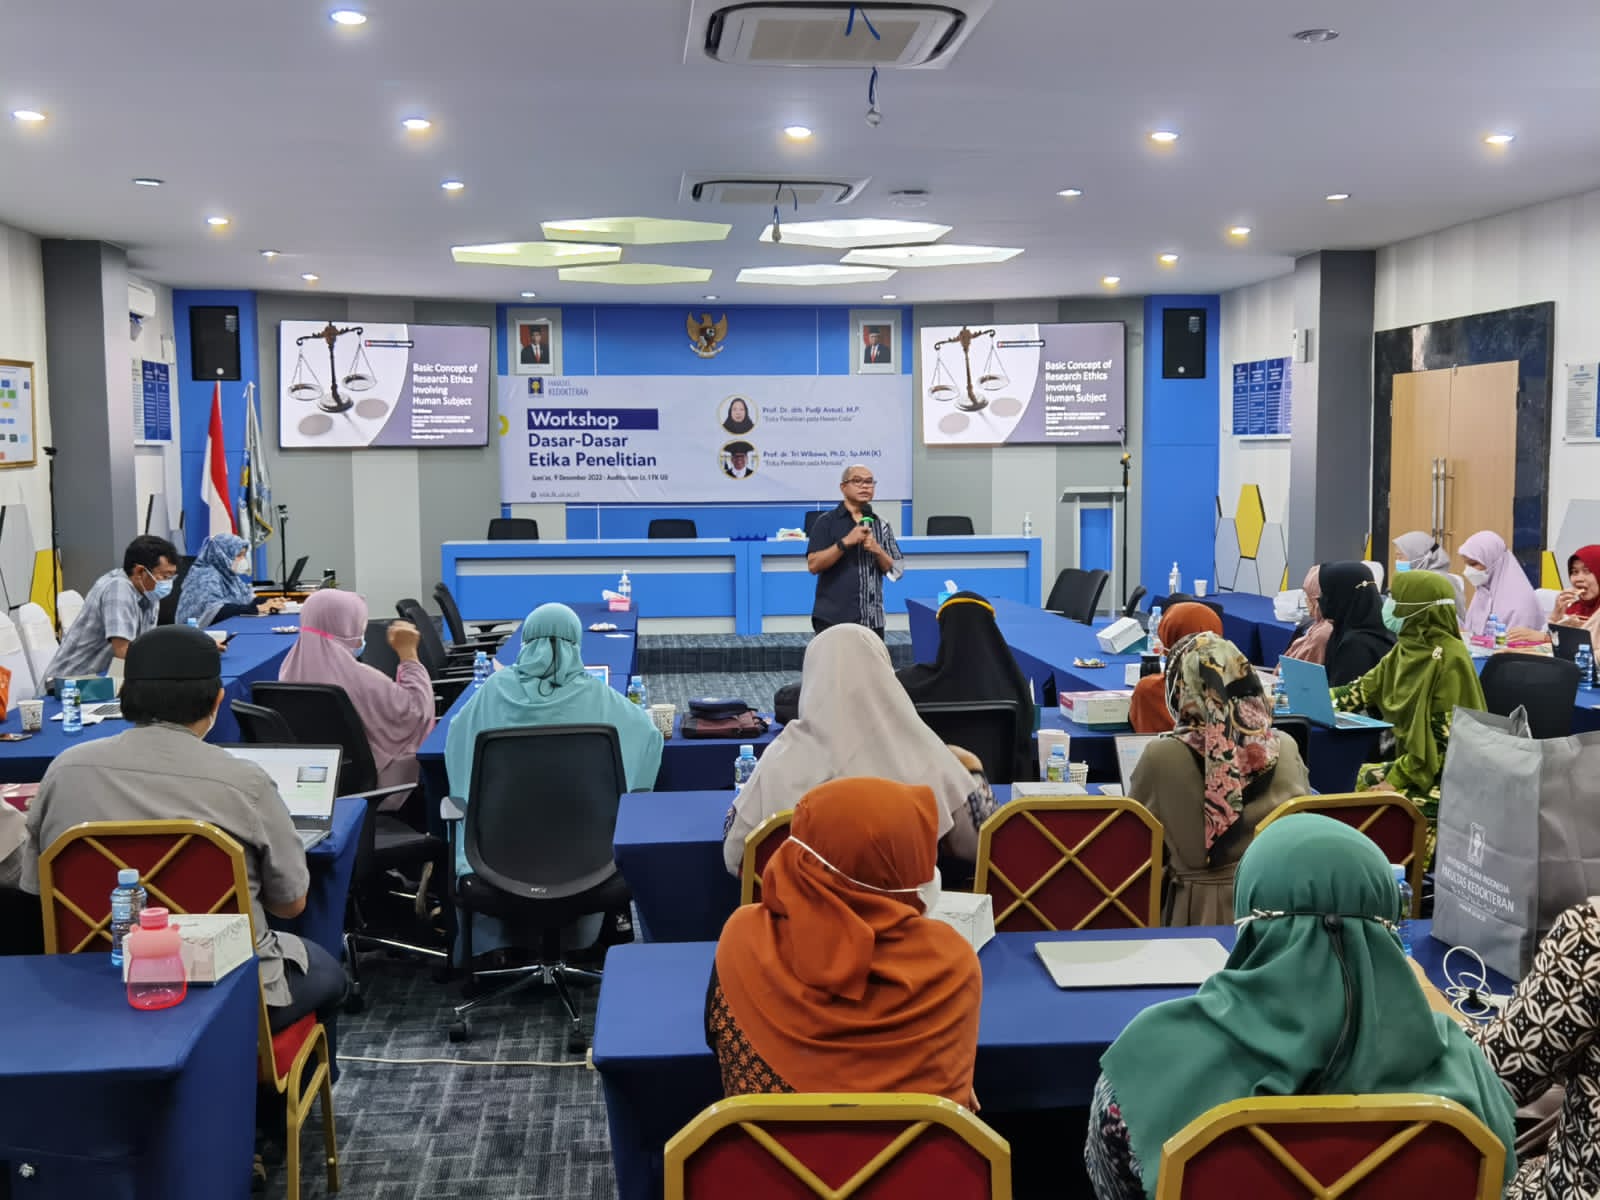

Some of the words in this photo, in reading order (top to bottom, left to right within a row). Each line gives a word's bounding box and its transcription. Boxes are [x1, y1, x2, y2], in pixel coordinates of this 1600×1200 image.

[413, 363, 434, 372] Basic
[434, 364, 468, 373] Concept
[468, 364, 478, 372] of
[1046, 361, 1066, 370] Basic
[1067, 361, 1101, 370] Concept
[1102, 360, 1112, 369] of
[413, 374, 449, 383] Research
[450, 375, 473, 384] Ethics
[1046, 372, 1082, 381] Research
[1083, 372, 1108, 381] Ethics
[413, 385, 448, 395] Involving
[1046, 382, 1081, 392] Involving
[413, 397, 442, 405] Human
[443, 396, 472, 406] Subject
[1046, 394, 1075, 402] Human
[1076, 393, 1107, 403] Subject
[530, 411, 619, 430] Workshop
[528, 433, 629, 448] Dasar-Dasar
[528, 452, 571, 467] Etika
[575, 451, 657, 467] Penelitian
[1467, 880, 1515, 913] KEDOKTERAN
